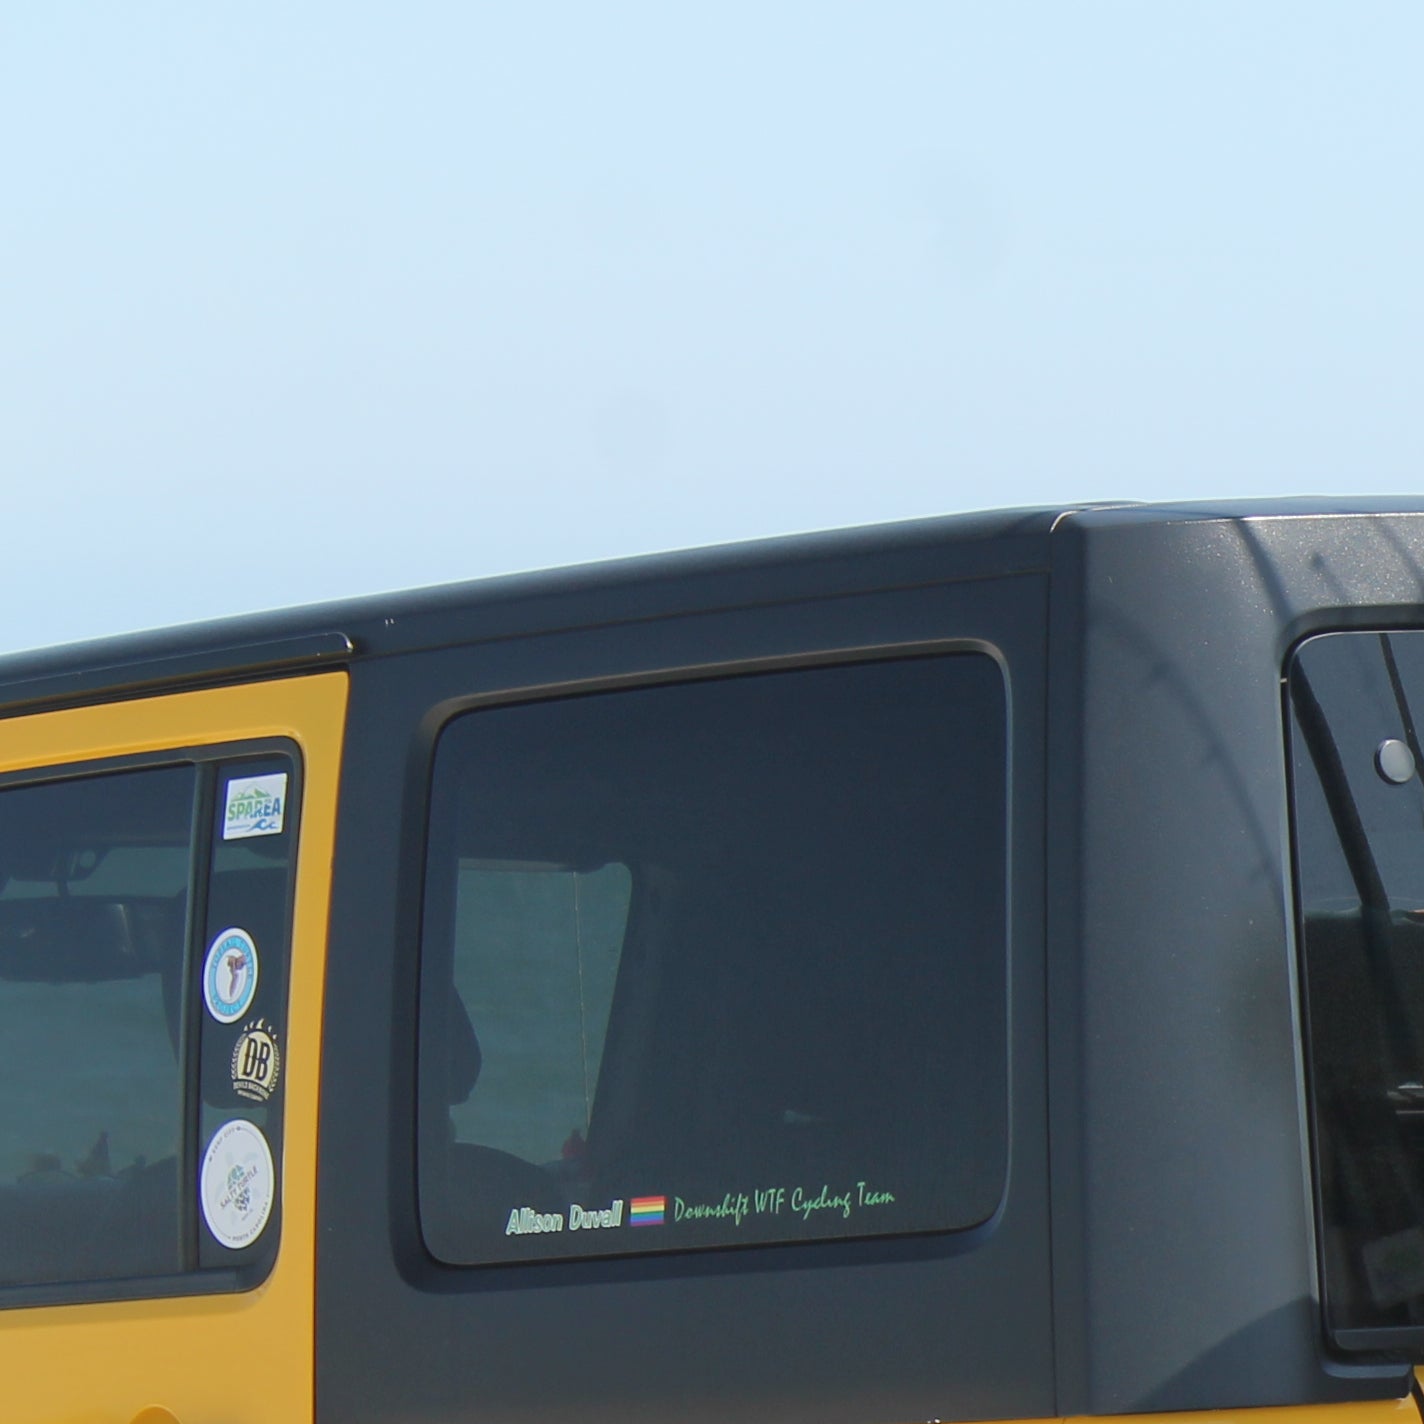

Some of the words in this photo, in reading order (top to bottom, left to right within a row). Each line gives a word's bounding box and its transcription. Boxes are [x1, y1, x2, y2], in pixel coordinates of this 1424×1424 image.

[228, 797, 281, 821] SPAREA
[242, 1036, 270, 1082] DB
[505, 1207, 563, 1235] Allison
[569, 1199, 624, 1231] Duvall
[674, 1193, 749, 1226] Downshift
[754, 1188, 785, 1214] WTF
[791, 1185, 851, 1220] Cycling
[856, 1181, 895, 1207] Team
